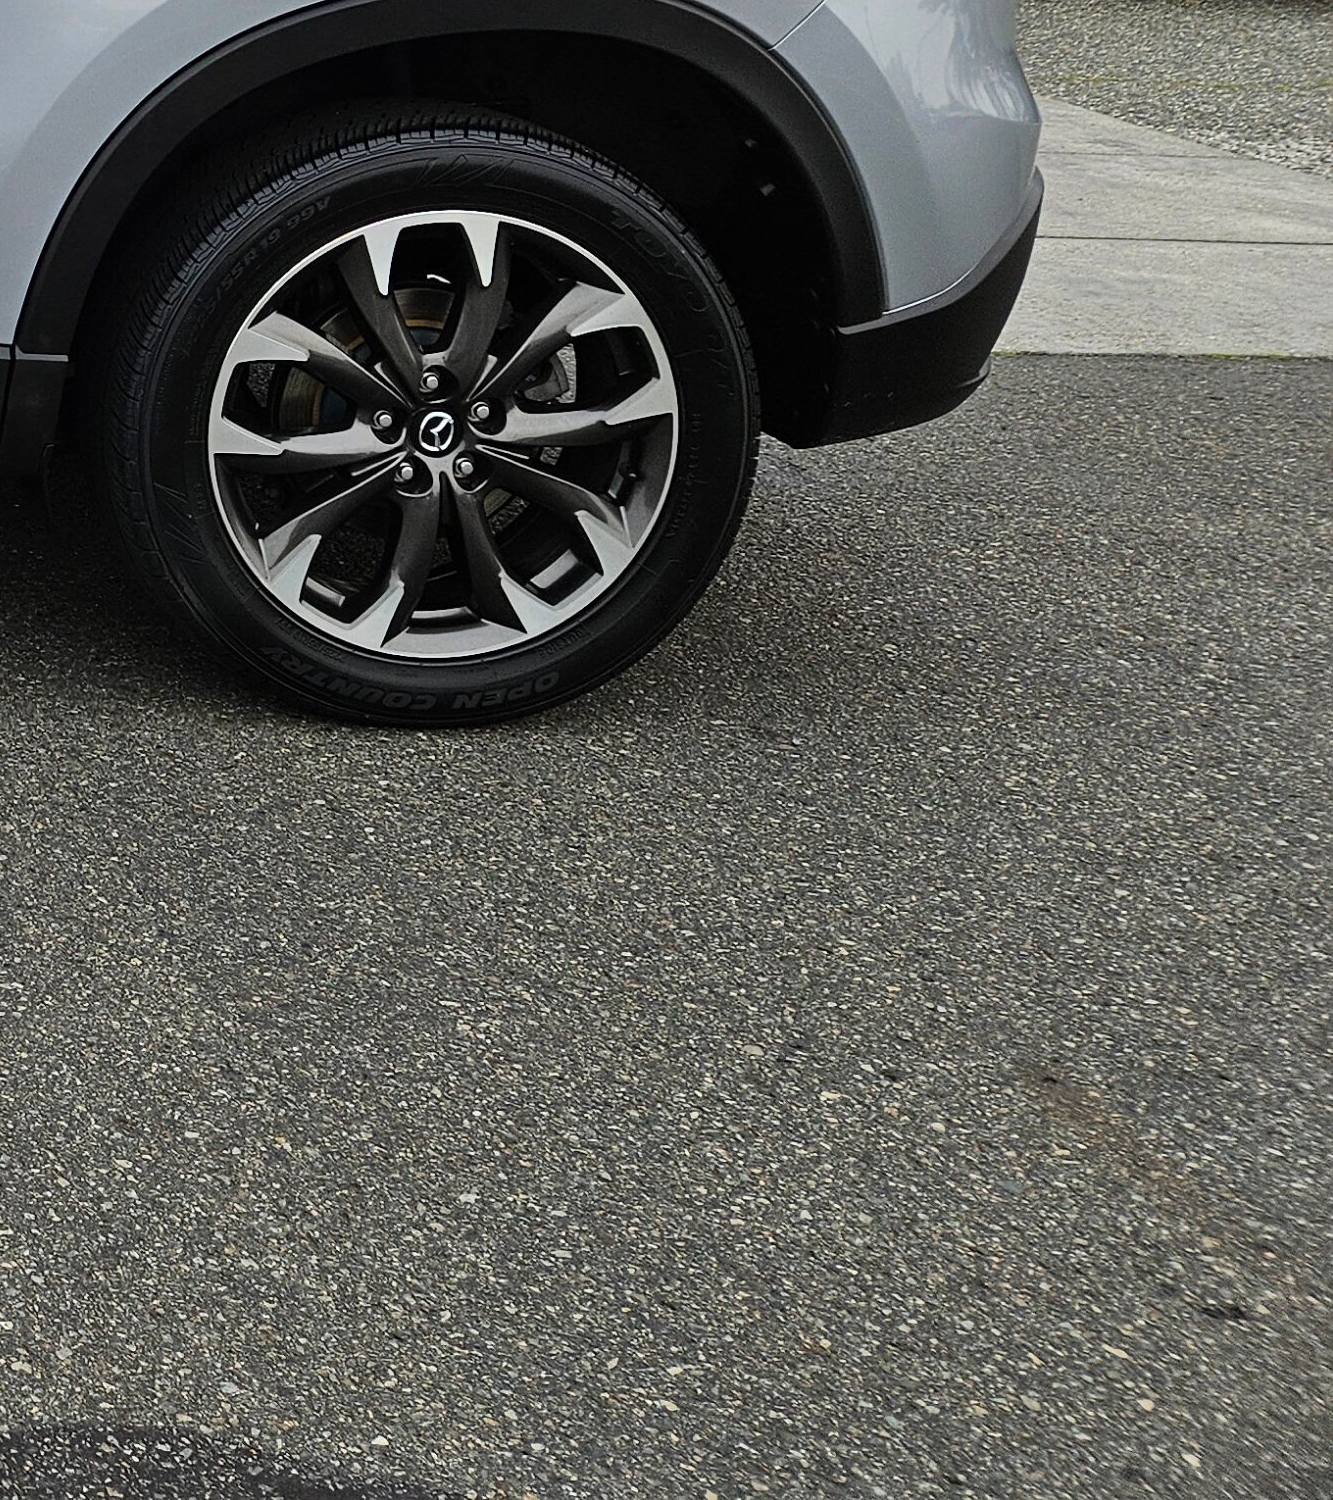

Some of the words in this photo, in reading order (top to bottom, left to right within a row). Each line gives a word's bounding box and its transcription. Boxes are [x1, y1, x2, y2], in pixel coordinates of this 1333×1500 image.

[609, 209, 713, 312] TOYO
[258, 646, 439, 711] COUNTRY
[451, 671, 561, 710] OPEN
